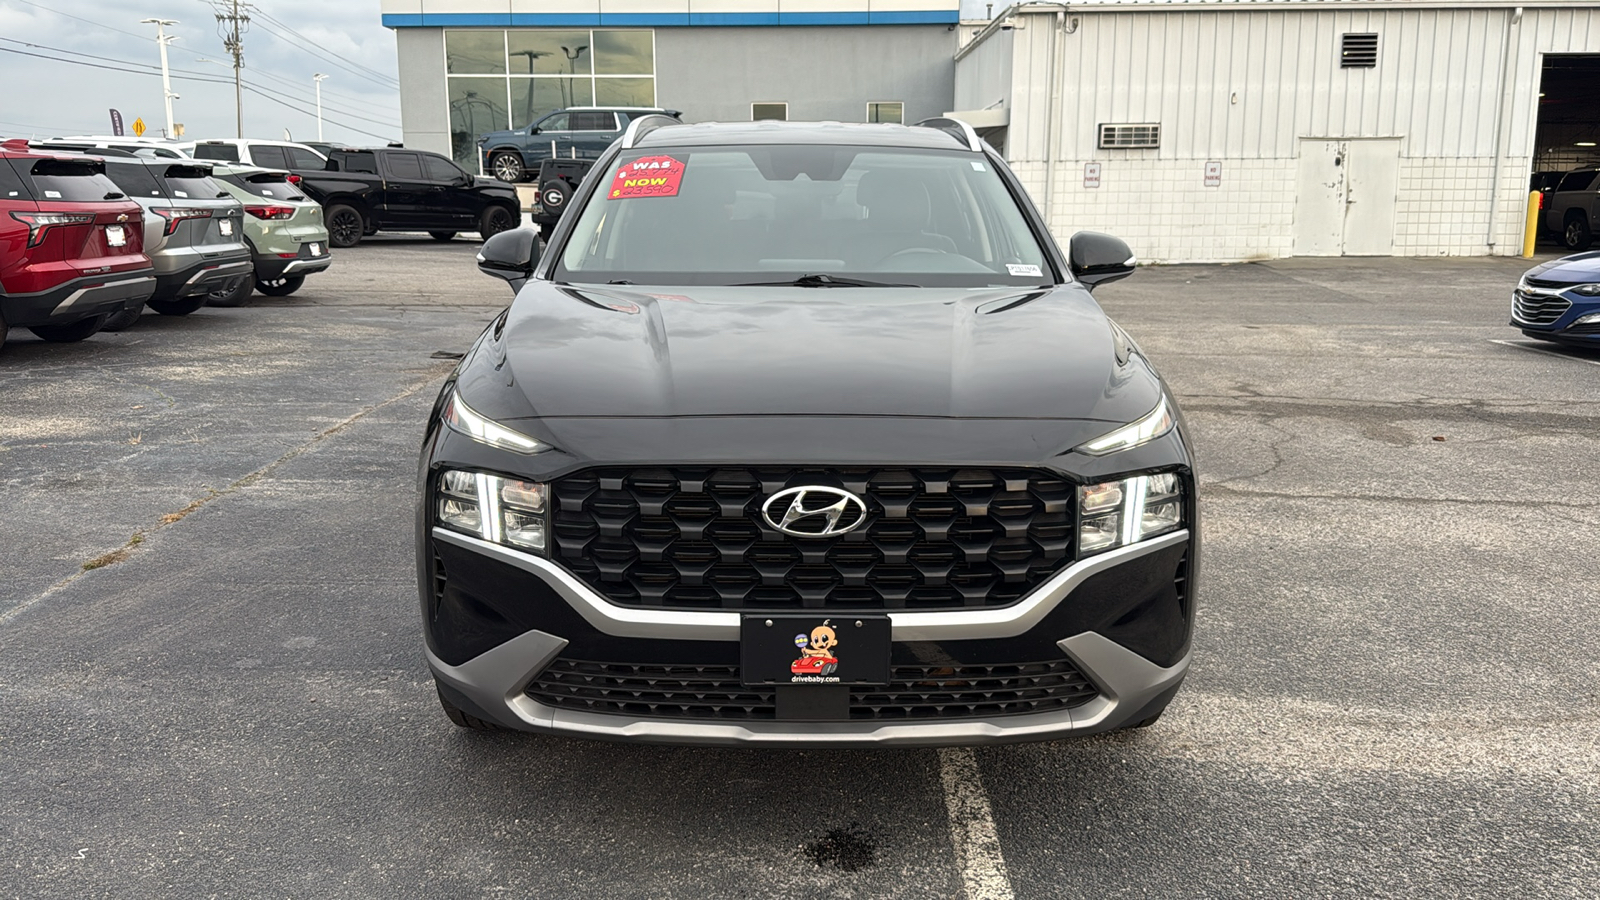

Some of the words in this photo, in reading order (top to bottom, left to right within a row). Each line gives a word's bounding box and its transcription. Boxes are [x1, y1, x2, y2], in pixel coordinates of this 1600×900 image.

[633, 161, 671, 170] WAS
[618, 171, 627, 179] $
[624, 177, 667, 187] NOW
[612, 189, 621, 197] $
[791, 675, 840, 684] drivebaby.com
